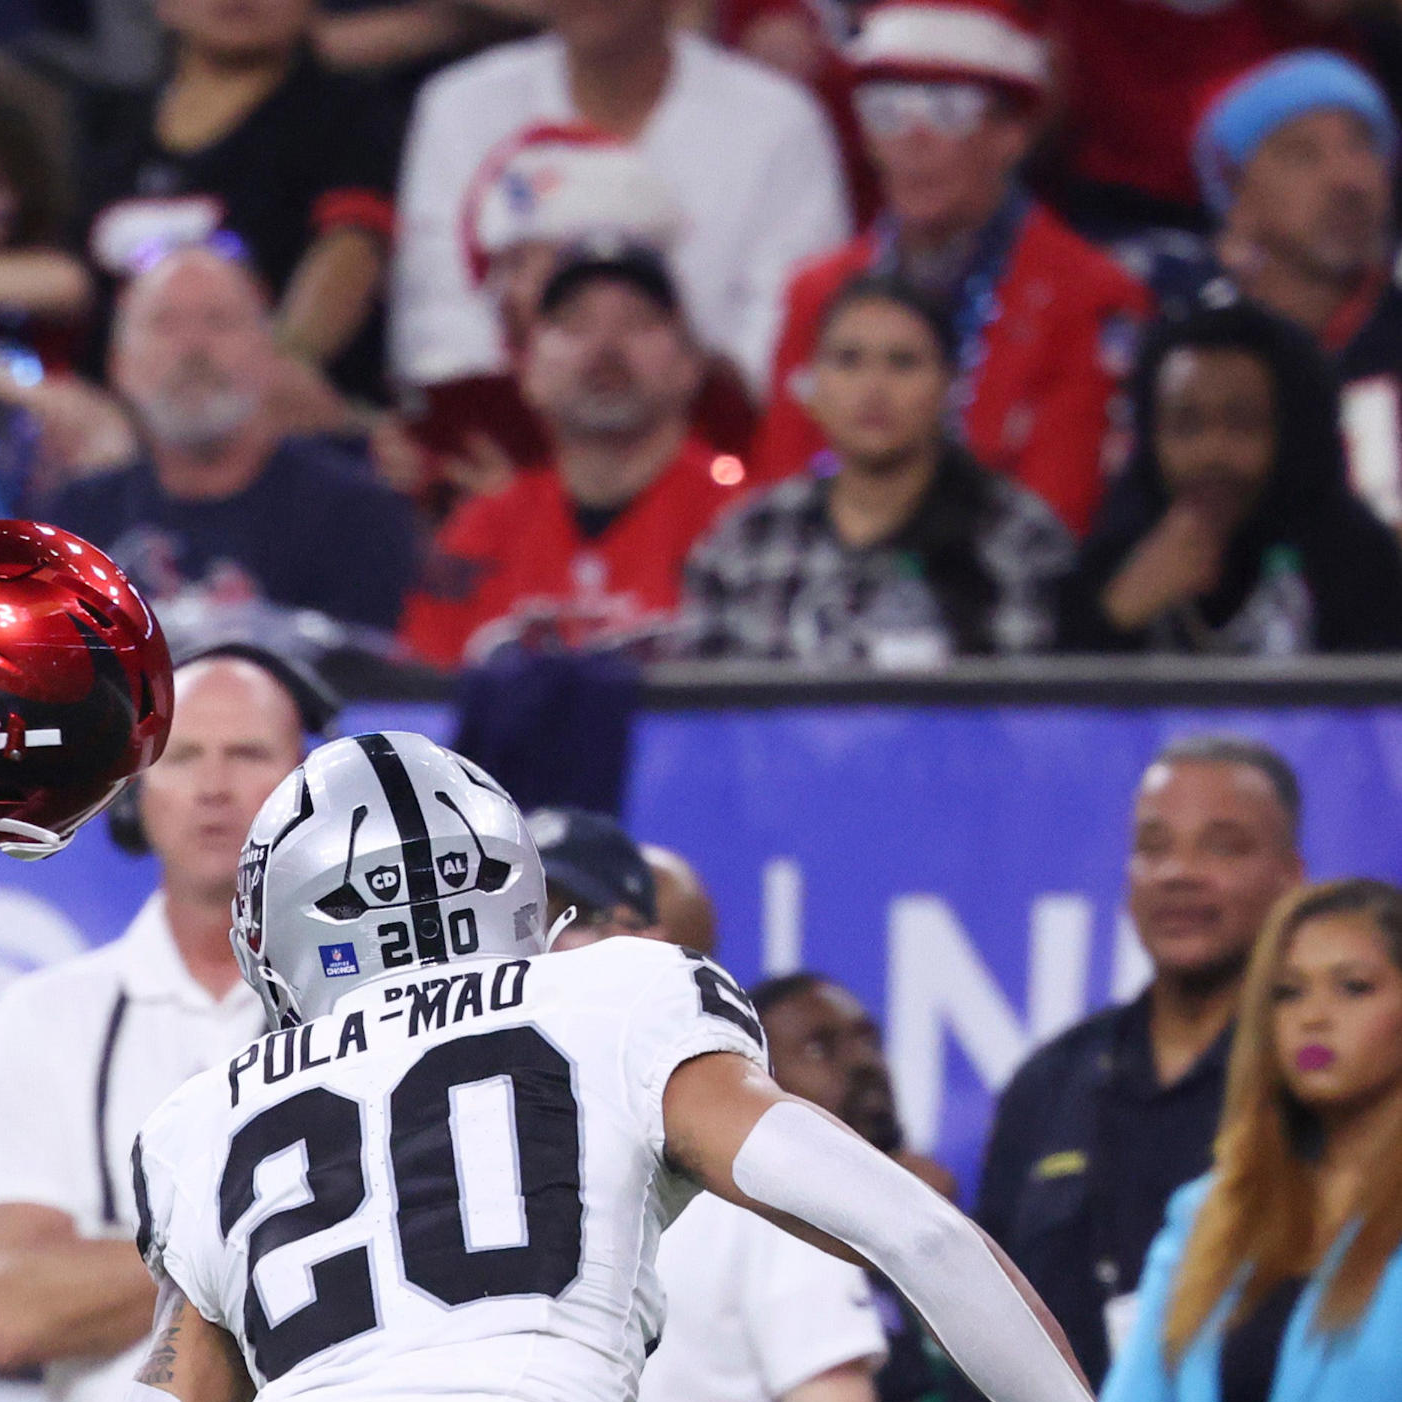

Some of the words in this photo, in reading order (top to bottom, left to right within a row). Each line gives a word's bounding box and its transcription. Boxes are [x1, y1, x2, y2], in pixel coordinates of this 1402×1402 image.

[370, 871, 398, 892] CD
[442, 858, 467, 877] AL
[216, 1022, 586, 1383] 20
